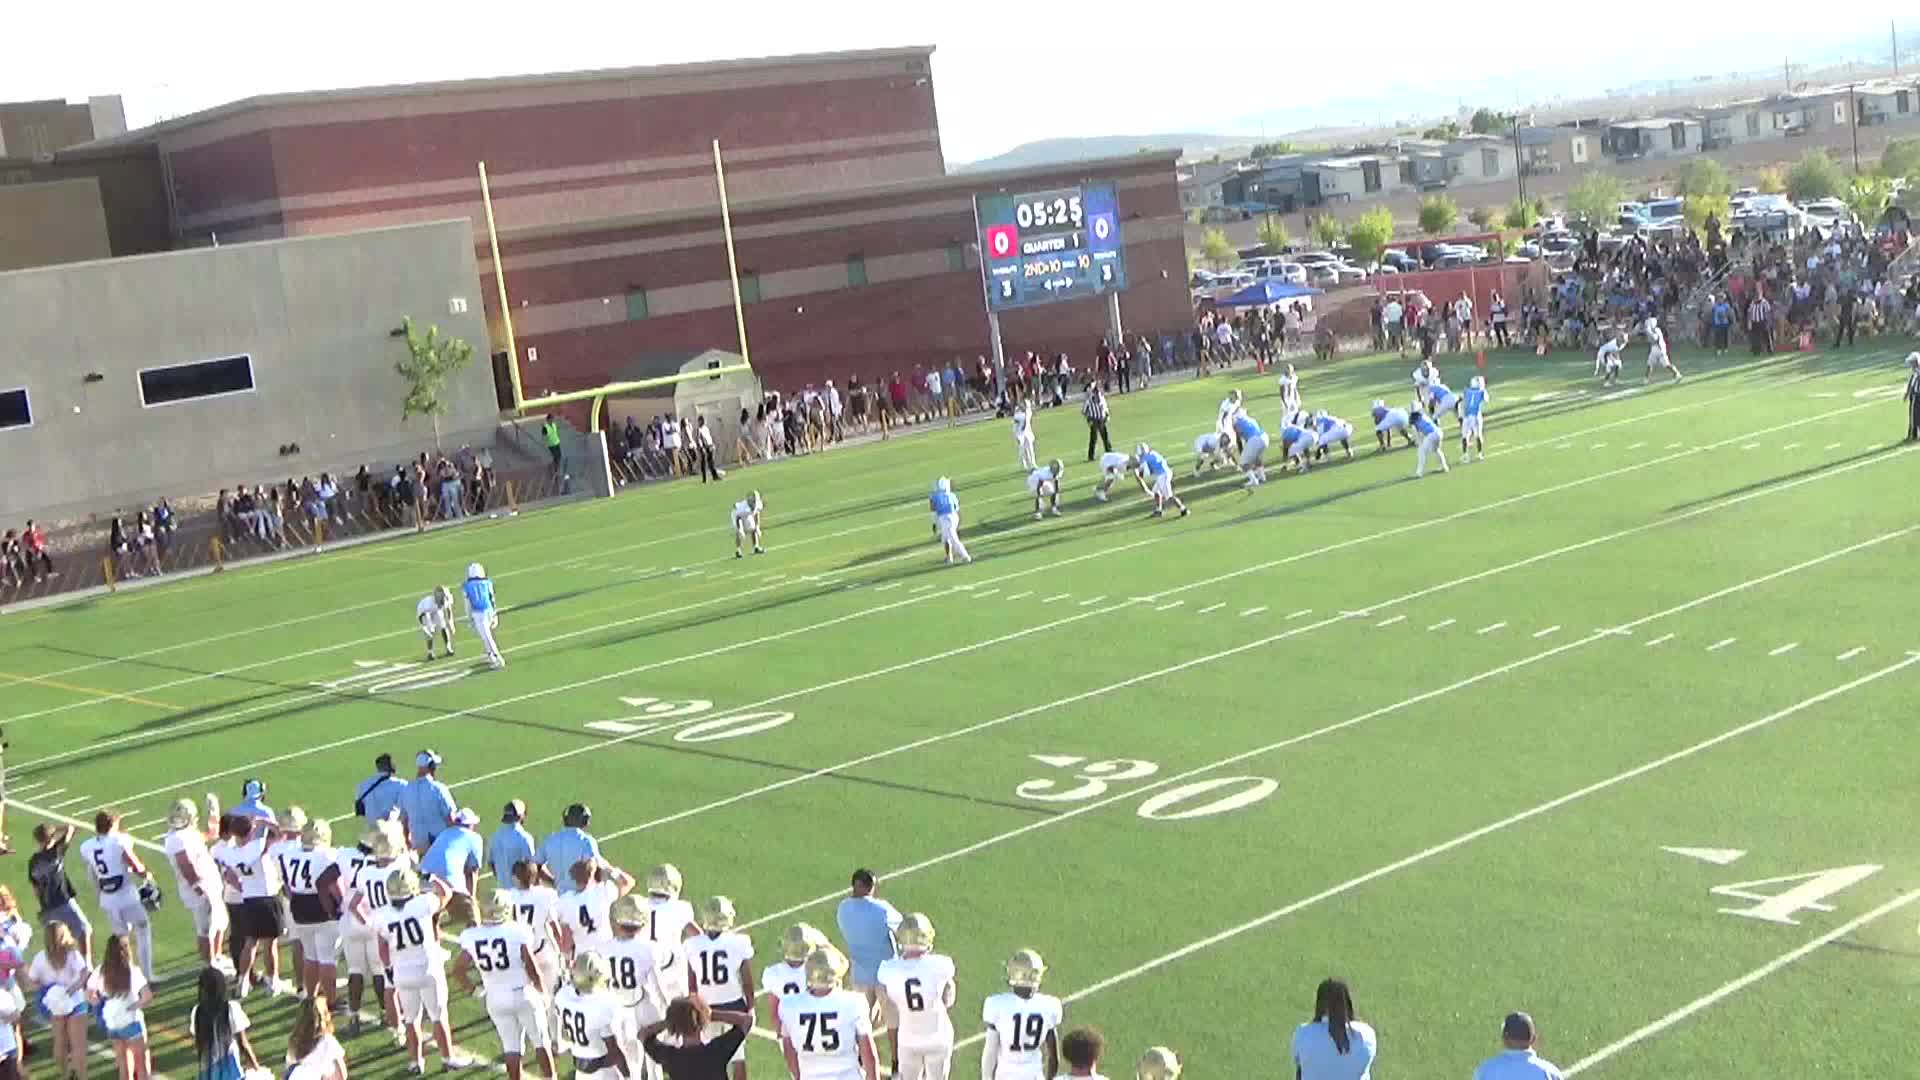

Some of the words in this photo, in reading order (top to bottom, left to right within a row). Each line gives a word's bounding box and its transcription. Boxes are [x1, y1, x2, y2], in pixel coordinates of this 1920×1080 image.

[1017, 197, 1082, 228] 05:25
[1095, 217, 1109, 239] 0
[994, 231, 1009, 254] 0
[1072, 232, 1079, 248] 1
[583, 699, 796, 742] 20
[1015, 758, 1280, 820] 30
[94, 849, 109, 875] 5
[289, 858, 313, 889] 74
[350, 858, 377, 889] 7
[366, 879, 388, 910] 10
[388, 916, 425, 951] 70
[579, 904, 597, 934] 4
[475, 937, 511, 972] 53
[699, 950, 729, 986] 16
[609, 955, 638, 990] 18
[904, 977, 925, 1012] 6
[562, 1007, 590, 1047] 68
[799, 1011, 841, 1052] 75
[1009, 1012, 1044, 1052] 19
